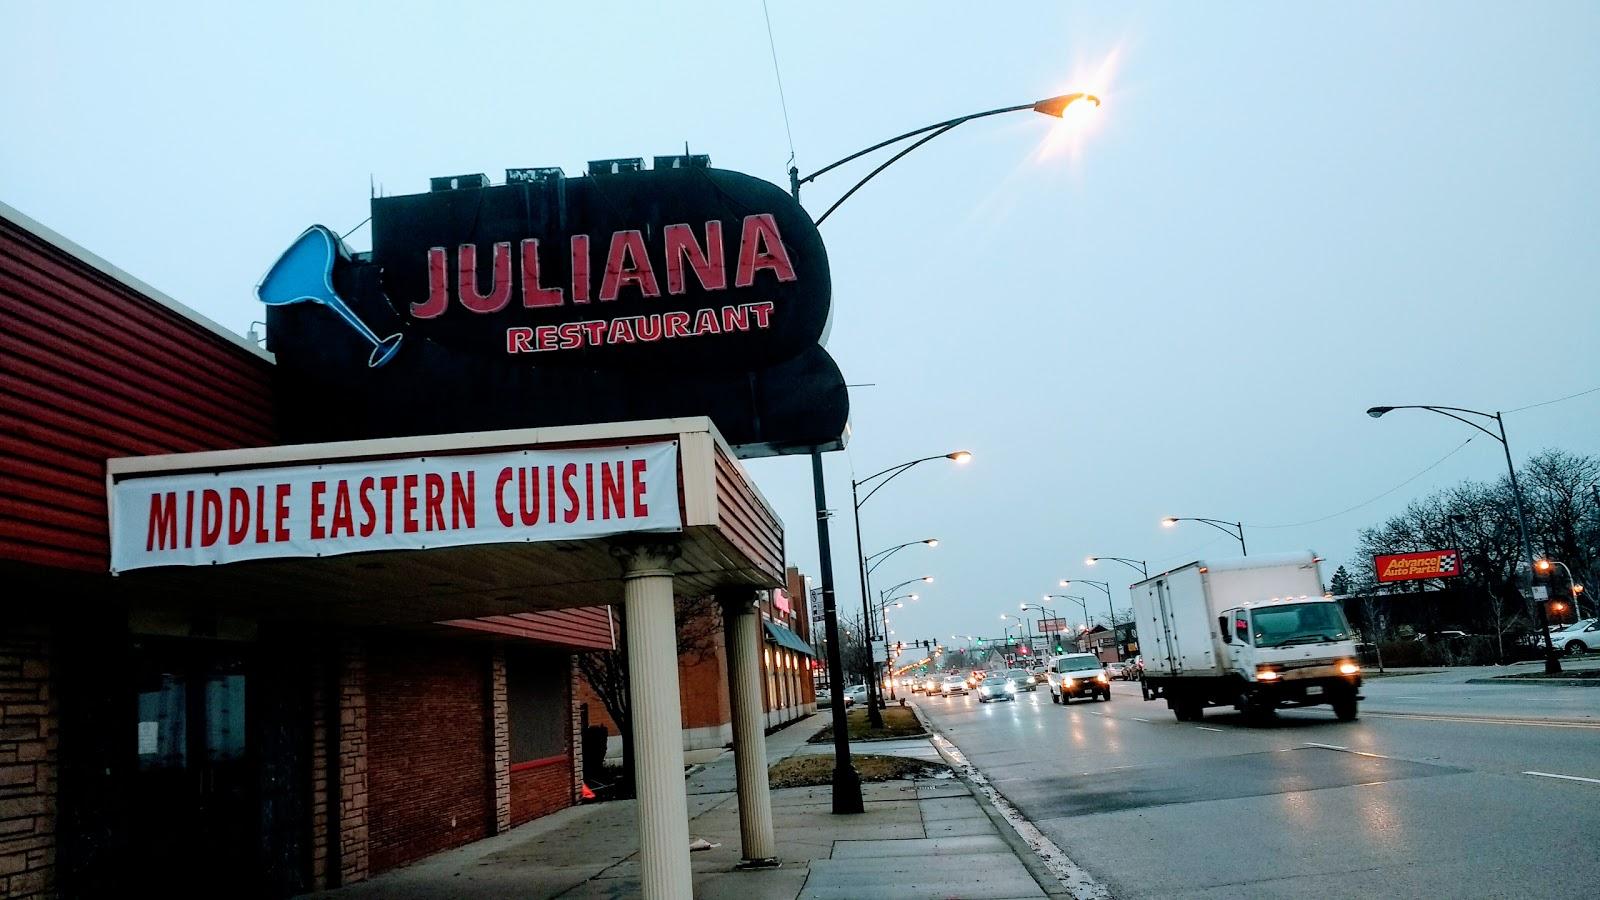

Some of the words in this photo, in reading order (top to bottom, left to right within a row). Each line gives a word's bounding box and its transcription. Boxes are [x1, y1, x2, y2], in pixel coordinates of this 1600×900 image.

[410, 213, 797, 320] JULIANA
[506, 301, 775, 354] RESTAURANT
[147, 484, 292, 552] MIDDLE
[310, 471, 476, 540] EASTERN
[495, 459, 648, 527] CUISINE
[1383, 567, 1409, 577] Auto
[1409, 565, 1437, 575] Parts
[1388, 557, 1437, 569] Advance
